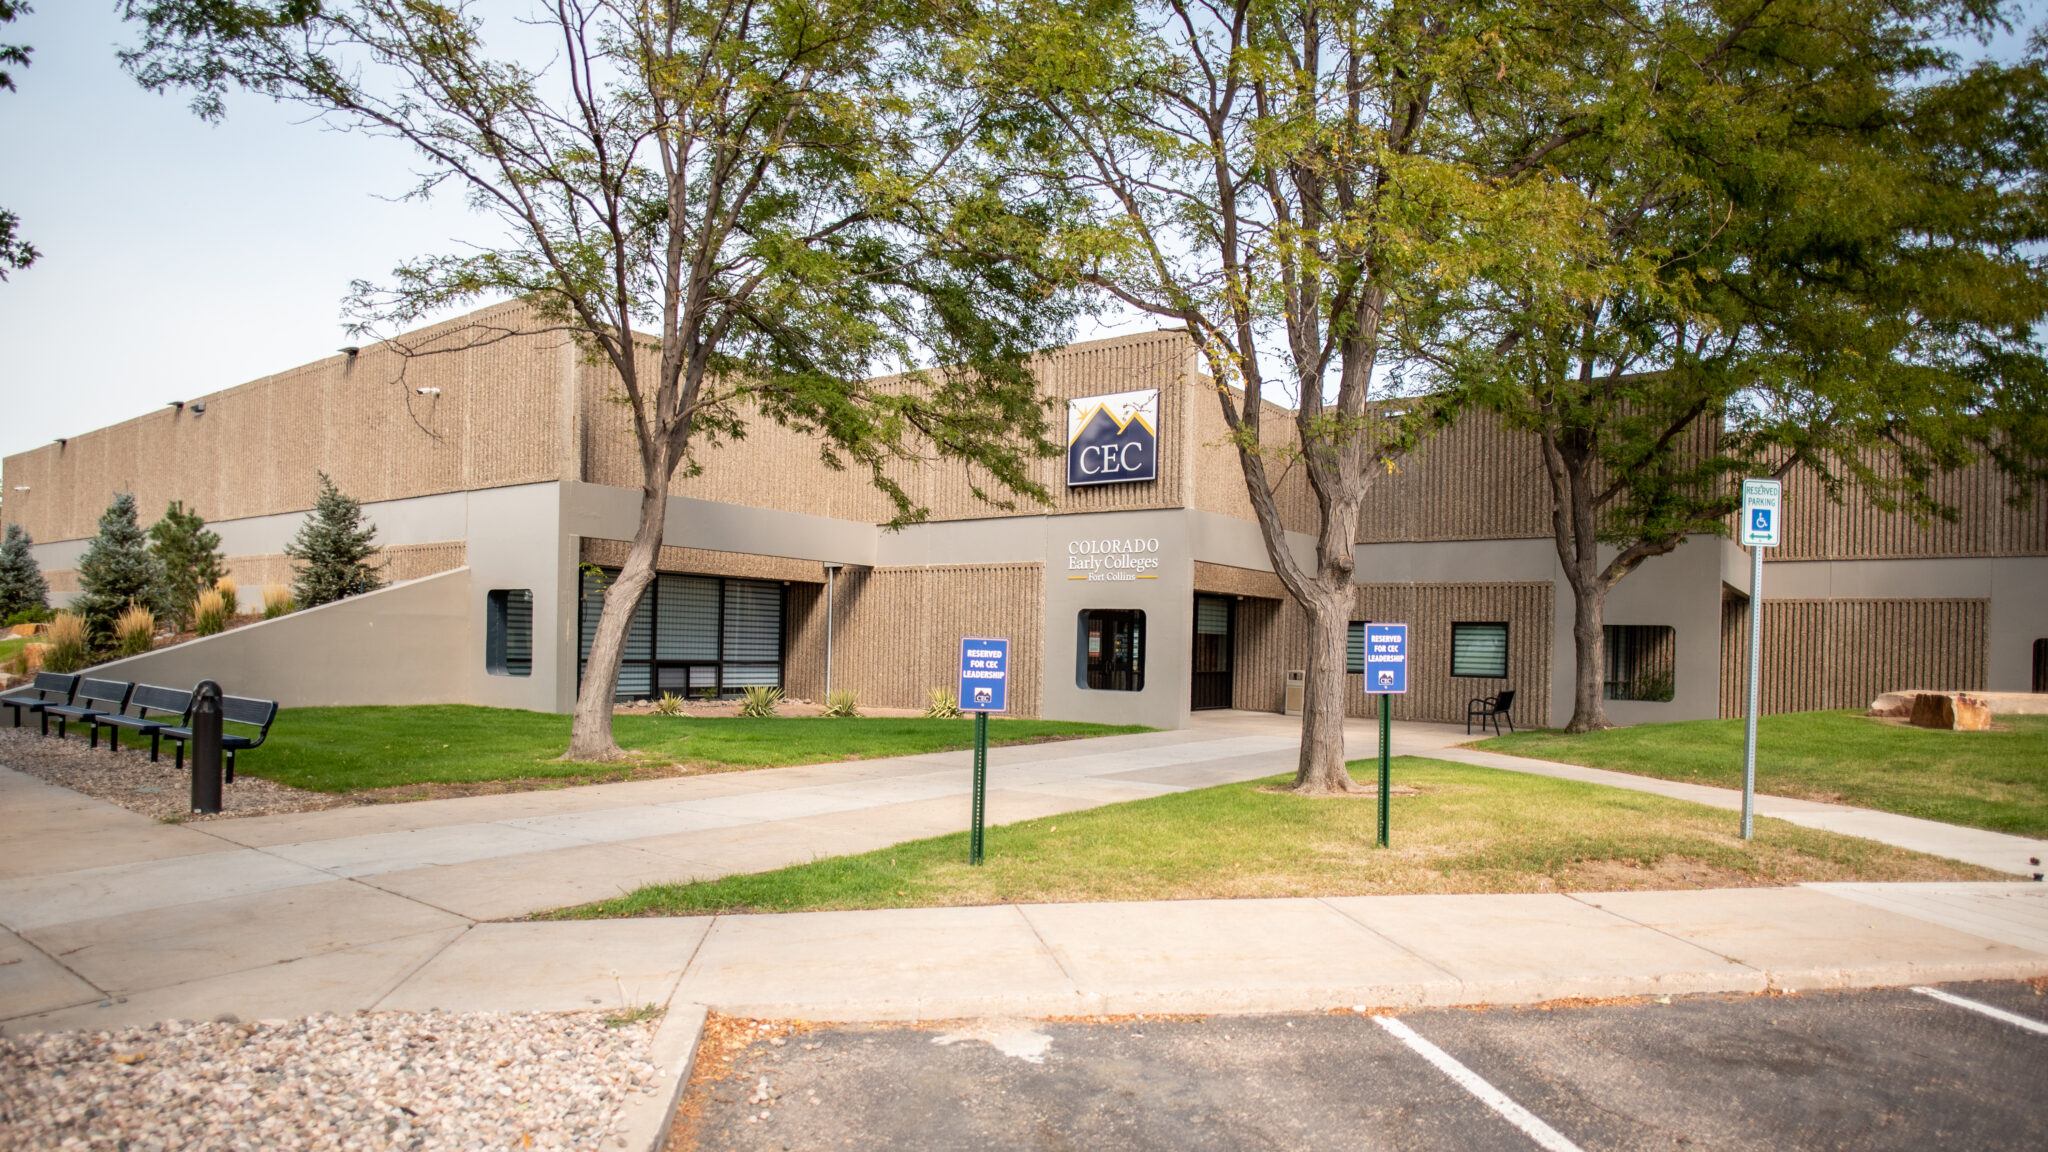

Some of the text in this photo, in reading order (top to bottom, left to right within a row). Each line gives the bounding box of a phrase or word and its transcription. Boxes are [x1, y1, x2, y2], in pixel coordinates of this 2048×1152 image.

[1080, 442, 1143, 475] CEC
[1746, 486, 1777, 496] RESERVED
[1748, 497, 1775, 506] PARKING
[1068, 538, 1159, 554] COLORADO
[1068, 554, 1158, 573] Early Colleges
[1087, 571, 1136, 581] Fort Collins
[967, 650, 1002, 658] RESERVED
[963, 670, 1005, 679] LEADERSHIP
